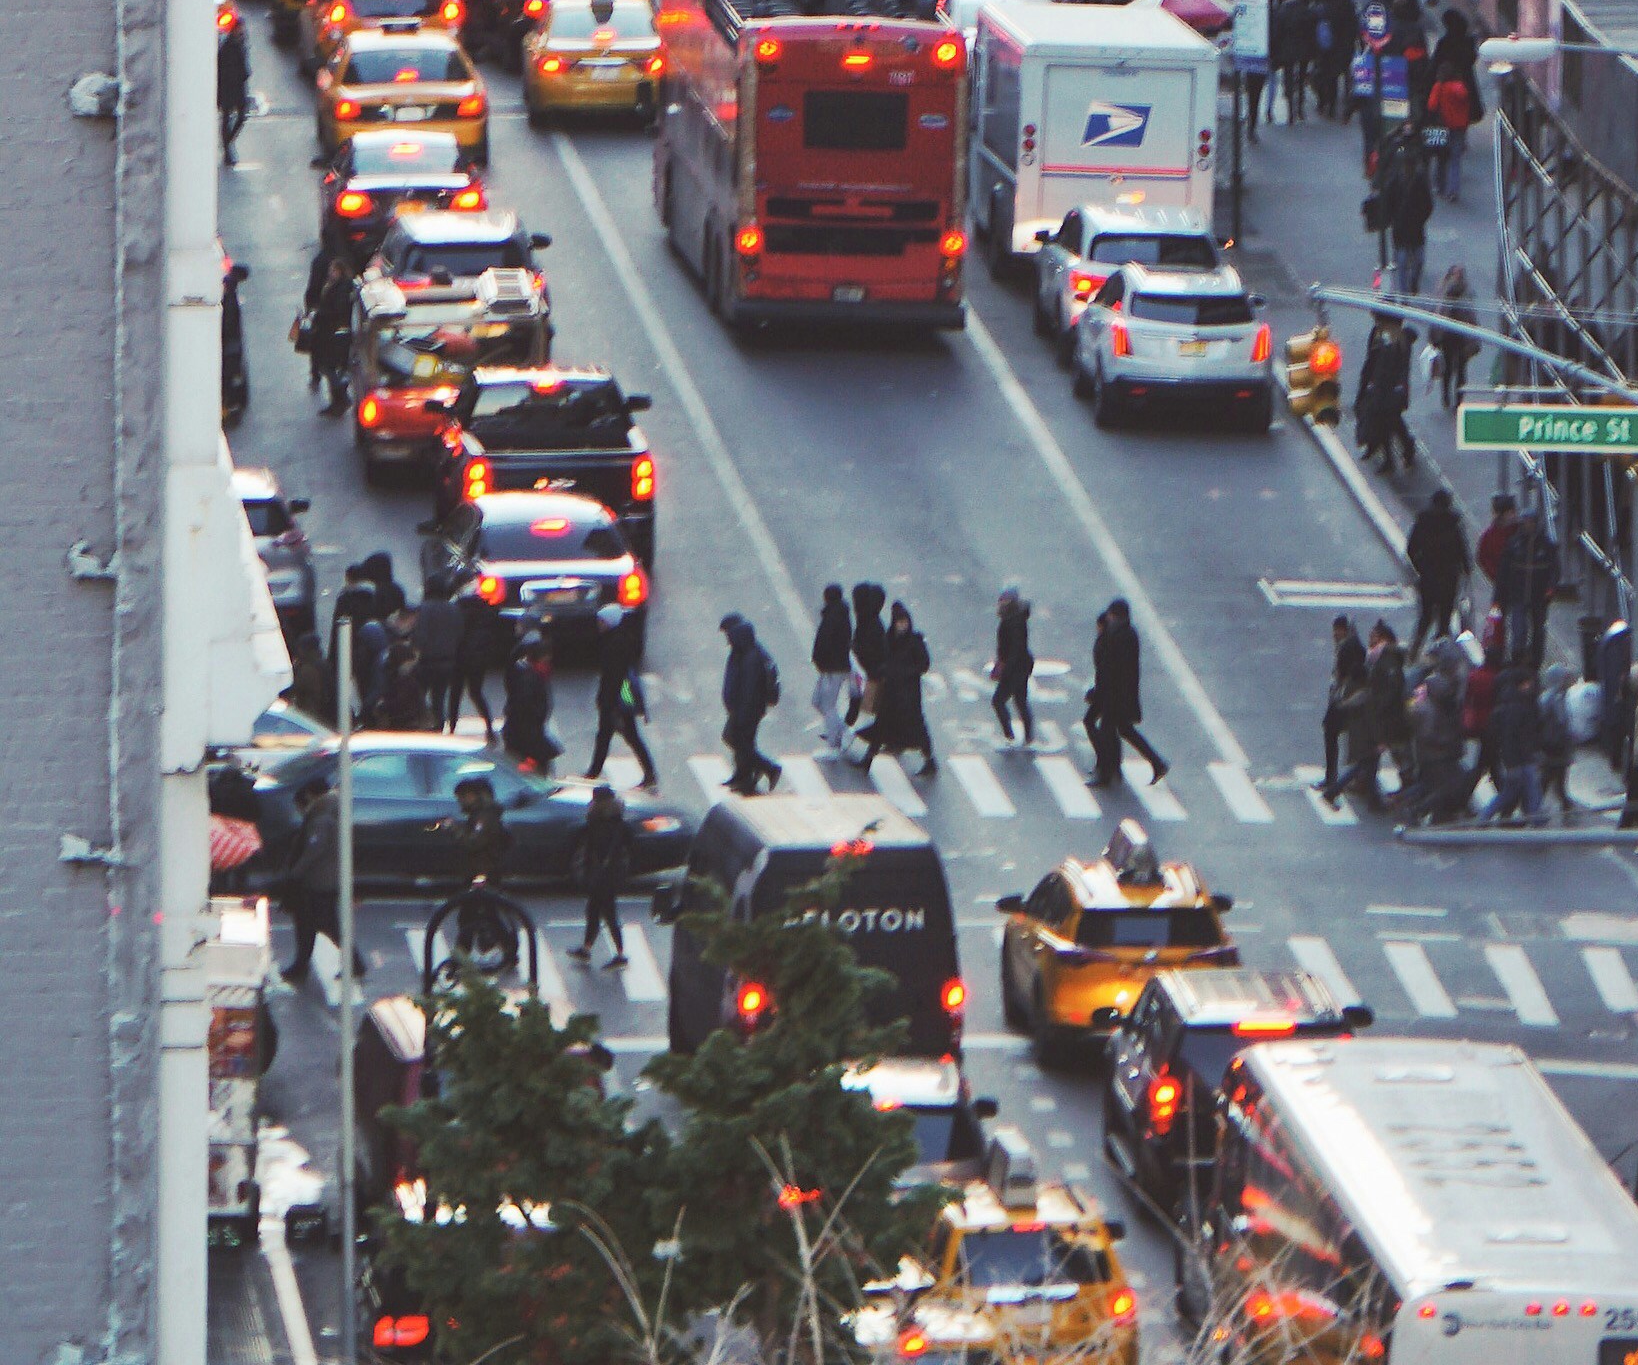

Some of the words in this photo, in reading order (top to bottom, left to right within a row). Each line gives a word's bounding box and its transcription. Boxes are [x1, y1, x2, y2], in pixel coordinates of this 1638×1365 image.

[1518, 415, 1598, 442] Prince
[1605, 418, 1631, 443] St
[781, 907, 926, 933] ELOTON
